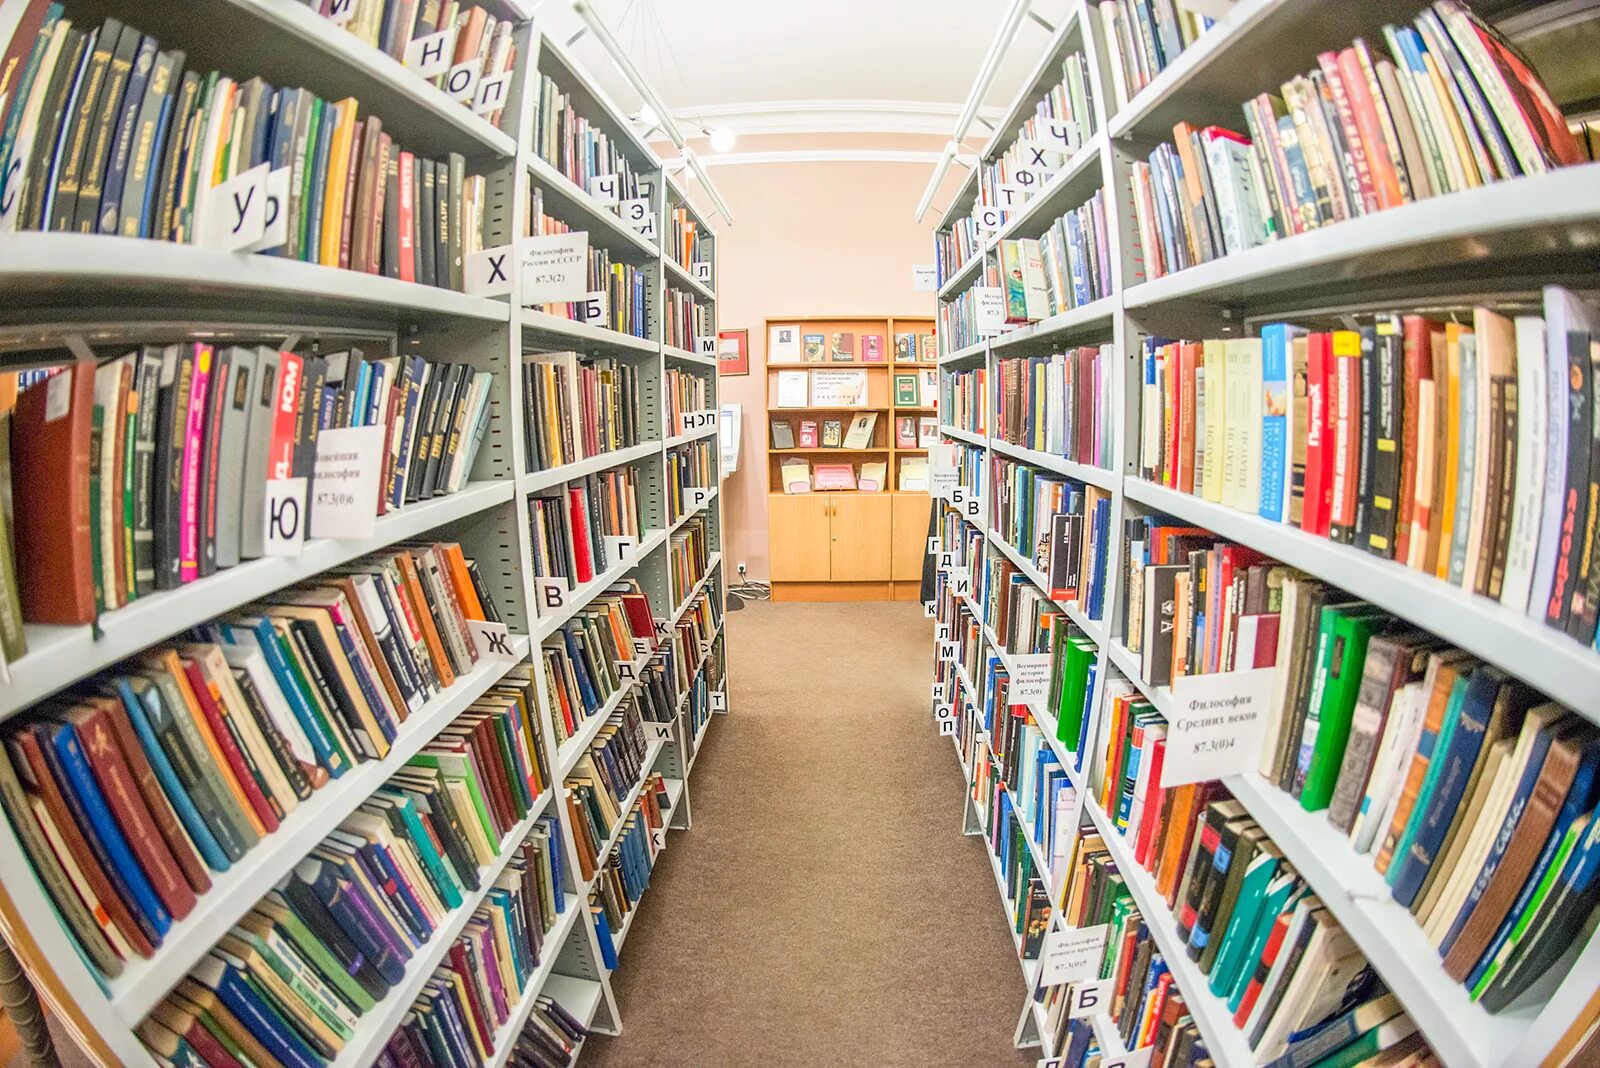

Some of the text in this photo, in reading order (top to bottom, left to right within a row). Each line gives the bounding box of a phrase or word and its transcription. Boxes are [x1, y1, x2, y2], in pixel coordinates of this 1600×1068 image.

[420, 38, 444, 66] Н
[450, 69, 471, 93] О
[482, 80, 504, 104] П
[115, 103, 138, 170] СПИНОЗА
[1050, 125, 1069, 146] Ч
[1030, 147, 1048, 167] Х
[401, 154, 413, 209] ФИХТЕ
[1016, 169, 1034, 186] Ф
[600, 181, 614, 198] Ч
[1002, 189, 1015, 205] Т
[233, 184, 256, 234] У
[631, 204, 644, 220] Э
[440, 199, 448, 245] ДЕКАРТ
[983, 211, 996, 226] С
[529, 246, 574, 257] Философия
[487, 254, 507, 285] Х
[522, 259, 549, 268] России
[558, 255, 582, 264] СССР
[535, 273, 565, 284] 87.3(2)
[699, 265, 708, 277] Л
[586, 298, 601, 318] Б
[703, 340, 714, 352] М
[282, 360, 298, 413] ЮМ
[684, 416, 695, 429] Н
[706, 413, 715, 425] П
[1205, 424, 1215, 480] ПЛАТОН
[1225, 427, 1235, 483] ПЛАТОН
[1239, 430, 1249, 489] ПЛАТОН
[695, 492, 704, 504] Р
[953, 490, 963, 503] Б
[968, 501, 979, 515] В
[269, 497, 298, 540] Ю
[618, 542, 630, 560] Г
[932, 540, 939, 550] Г
[941, 554, 952, 568] Д
[957, 579, 968, 592] И
[545, 586, 563, 608] В
[928, 604, 936, 615] К
[939, 627, 948, 639] Л
[481, 631, 513, 656] Ж
[634, 642, 647, 654] Е
[942, 646, 954, 658] М
[618, 664, 636, 680] Д
[934, 686, 943, 697] Н
[713, 695, 722, 706] Т
[1189, 694, 1252, 711] Философия
[938, 708, 949, 718] О
[943, 721, 953, 732] П
[1176, 711, 1257, 732] Средних веков
[656, 727, 669, 738] И
[1193, 738, 1235, 754] 87.3(0)4
[1057, 936, 1100, 948] Философия
[1050, 950, 1071, 958] нового
[1055, 959, 1088, 971] 87.3(0)5
[1078, 987, 1099, 1010] Б
